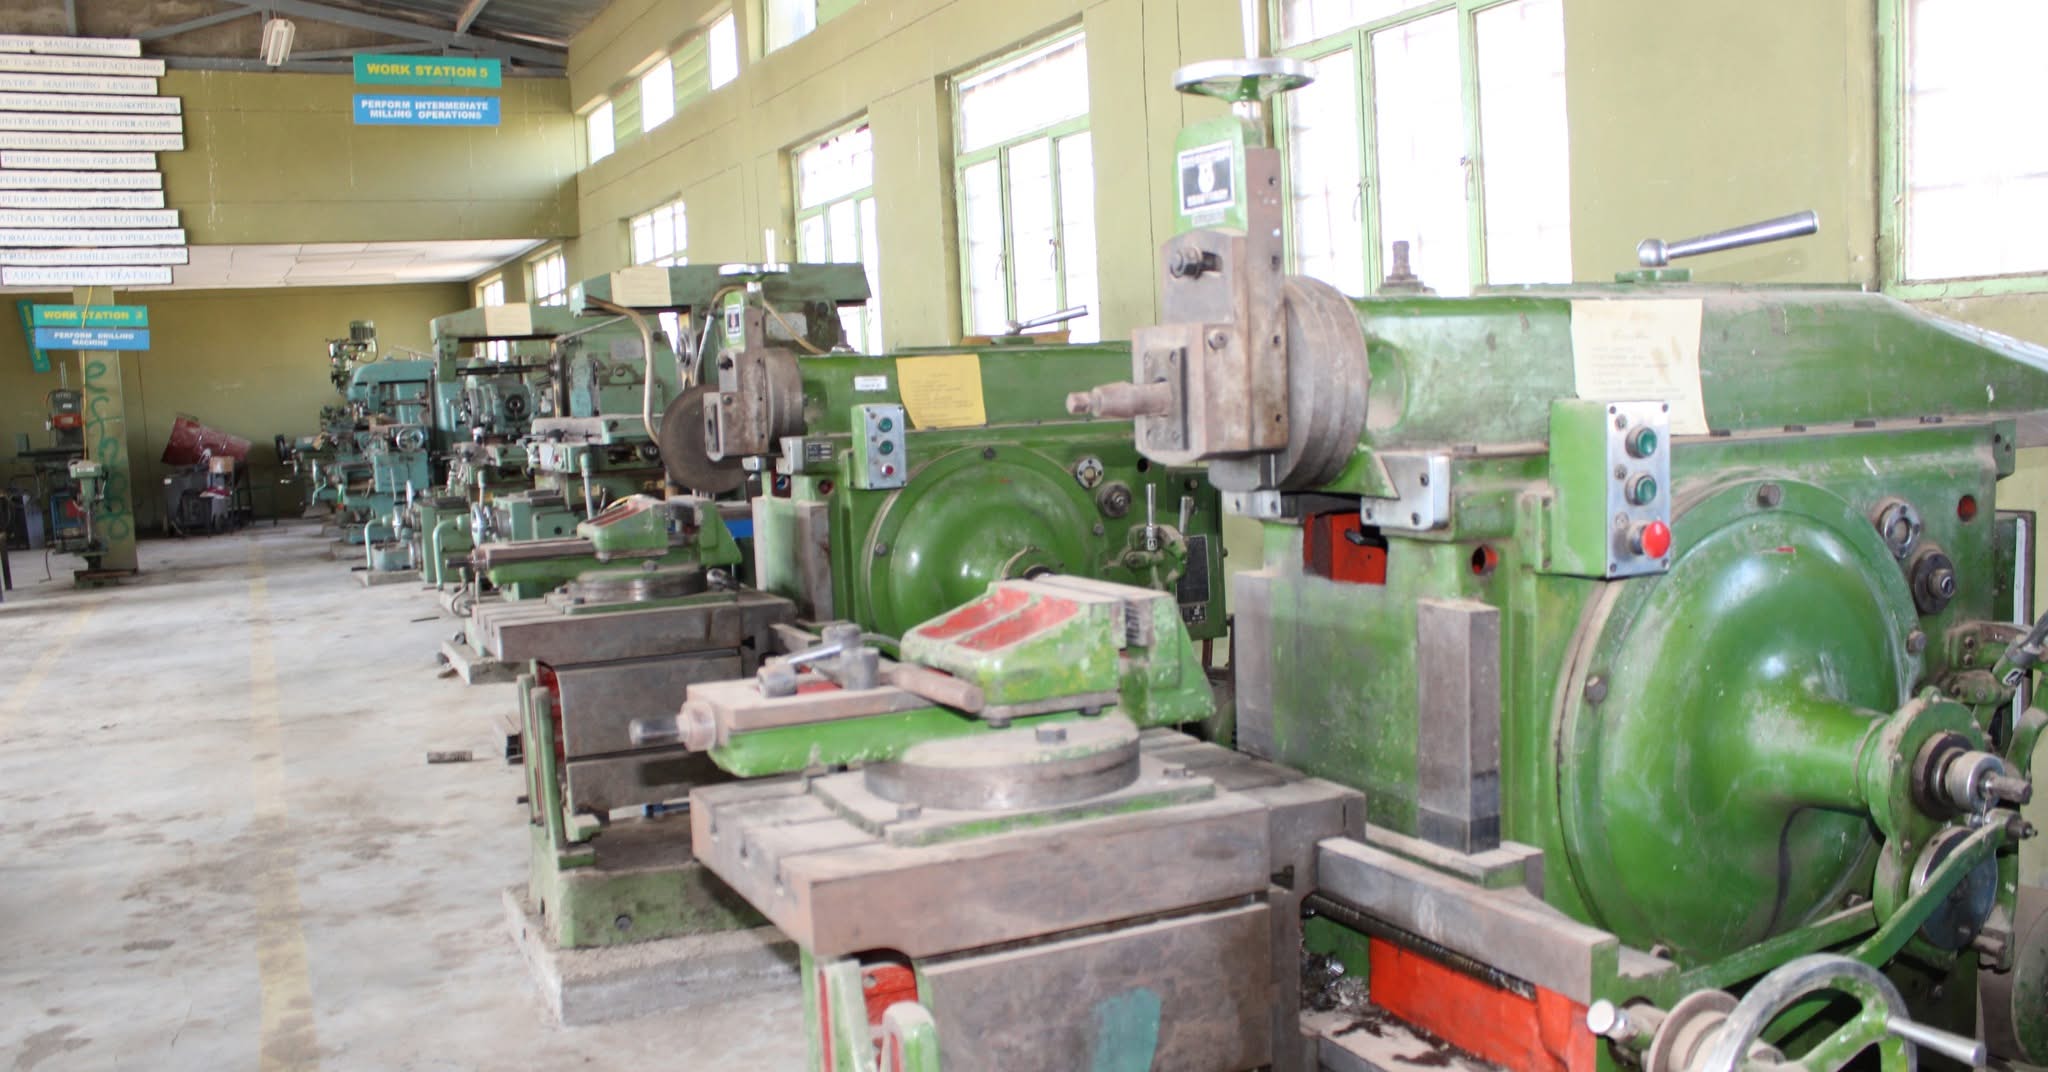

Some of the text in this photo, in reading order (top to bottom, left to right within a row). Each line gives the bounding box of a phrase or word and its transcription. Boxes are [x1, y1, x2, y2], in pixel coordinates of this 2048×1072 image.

[367, 63, 488, 78] WORK STATION 5
[361, 99, 488, 111] PERFORM INTERMEDIATE
[369, 109, 482, 120] MILLING OPERATIONS
[113, 215, 174, 224] EQUIPMENT
[44, 311, 77, 319] WORK
[81, 311, 129, 320] STATION
[54, 331, 92, 339] PERFORM
[72, 339, 108, 347] MACHINE
